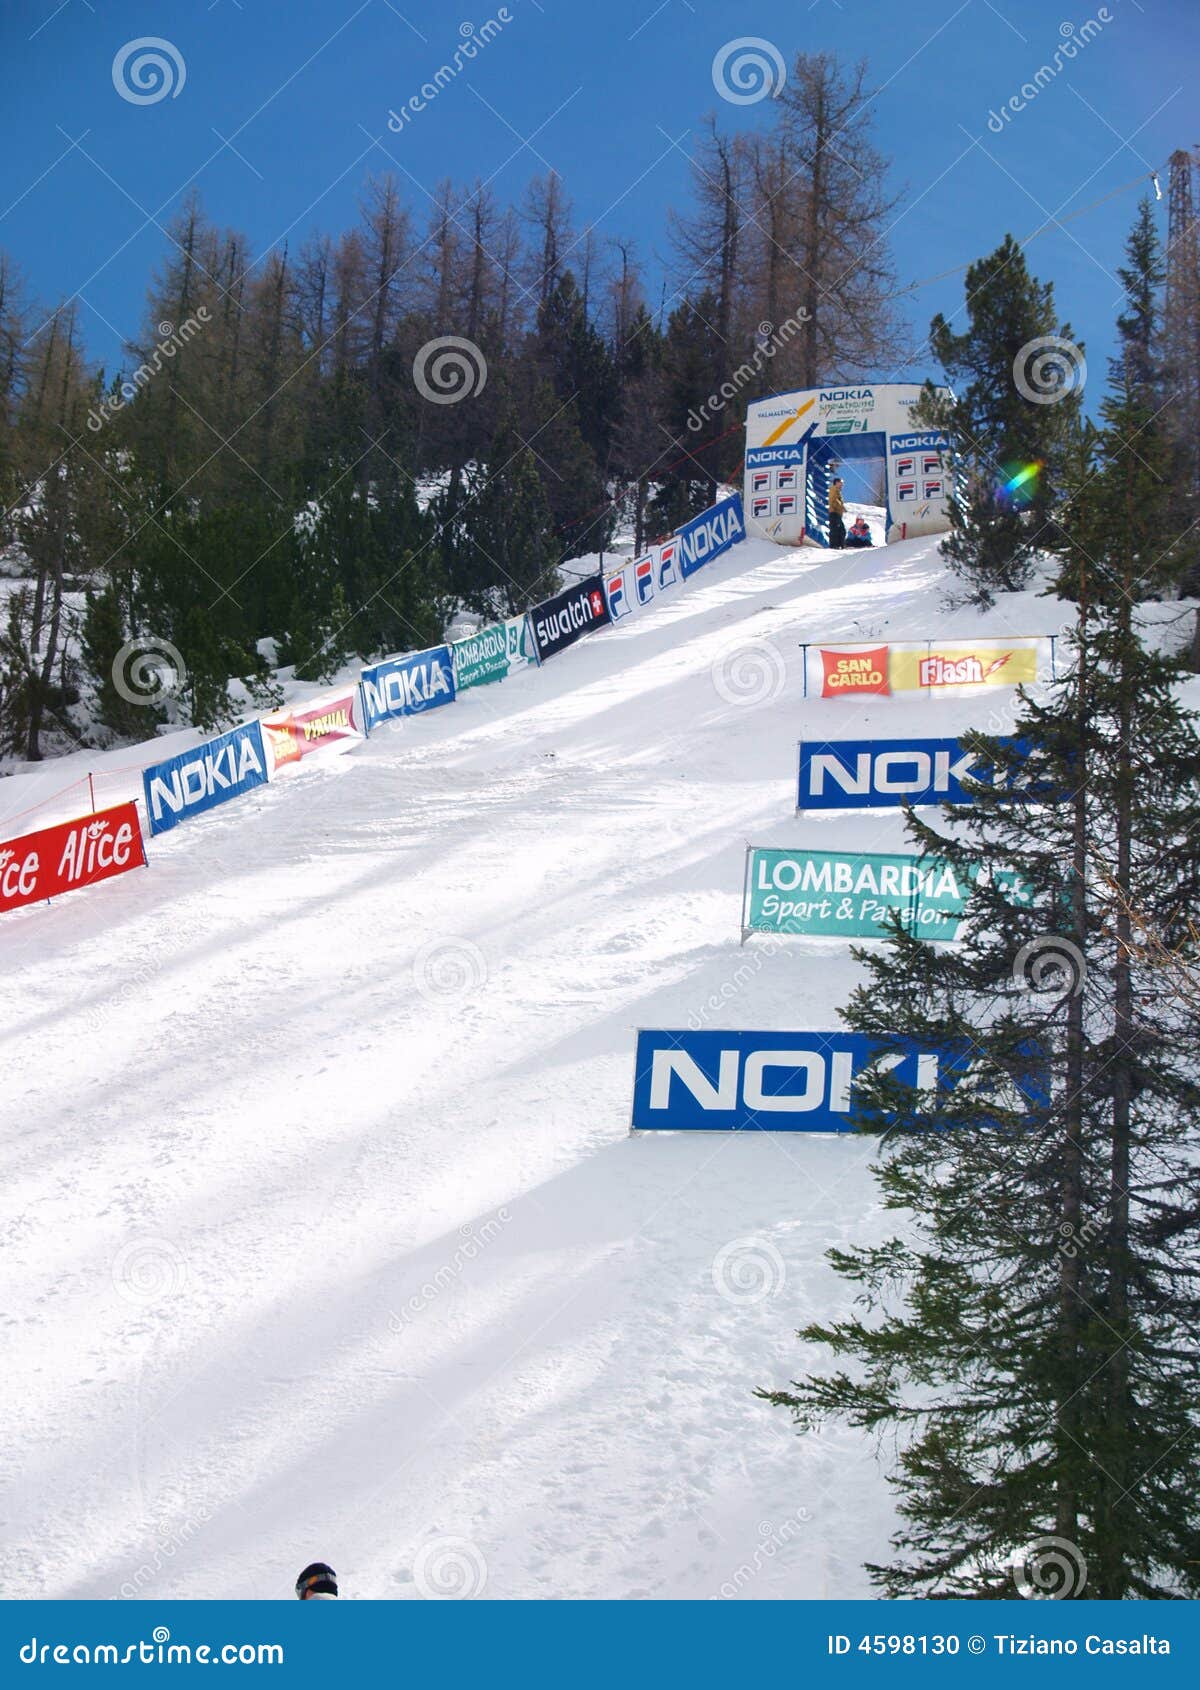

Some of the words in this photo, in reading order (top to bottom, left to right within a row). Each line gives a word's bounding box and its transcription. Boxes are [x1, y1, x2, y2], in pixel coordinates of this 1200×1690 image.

[820, 389, 873, 401] NOKIA
[748, 449, 801, 463] NOKIA
[892, 436, 947, 449] NOKIA
[682, 507, 742, 568] NOKIA
[537, 593, 593, 647] swatch
[827, 671, 883, 687] CARLO
[837, 657, 872, 674] SAN
[920, 655, 985, 688] Flash
[363, 661, 450, 717] NOKIA
[150, 737, 263, 820] NOKIA
[809, 748, 1058, 796] NOK
[58, 820, 133, 883] Alice
[757, 859, 961, 900] LOMBARDIA
[761, 895, 832, 925] Sport
[835, 899, 855, 919] &
